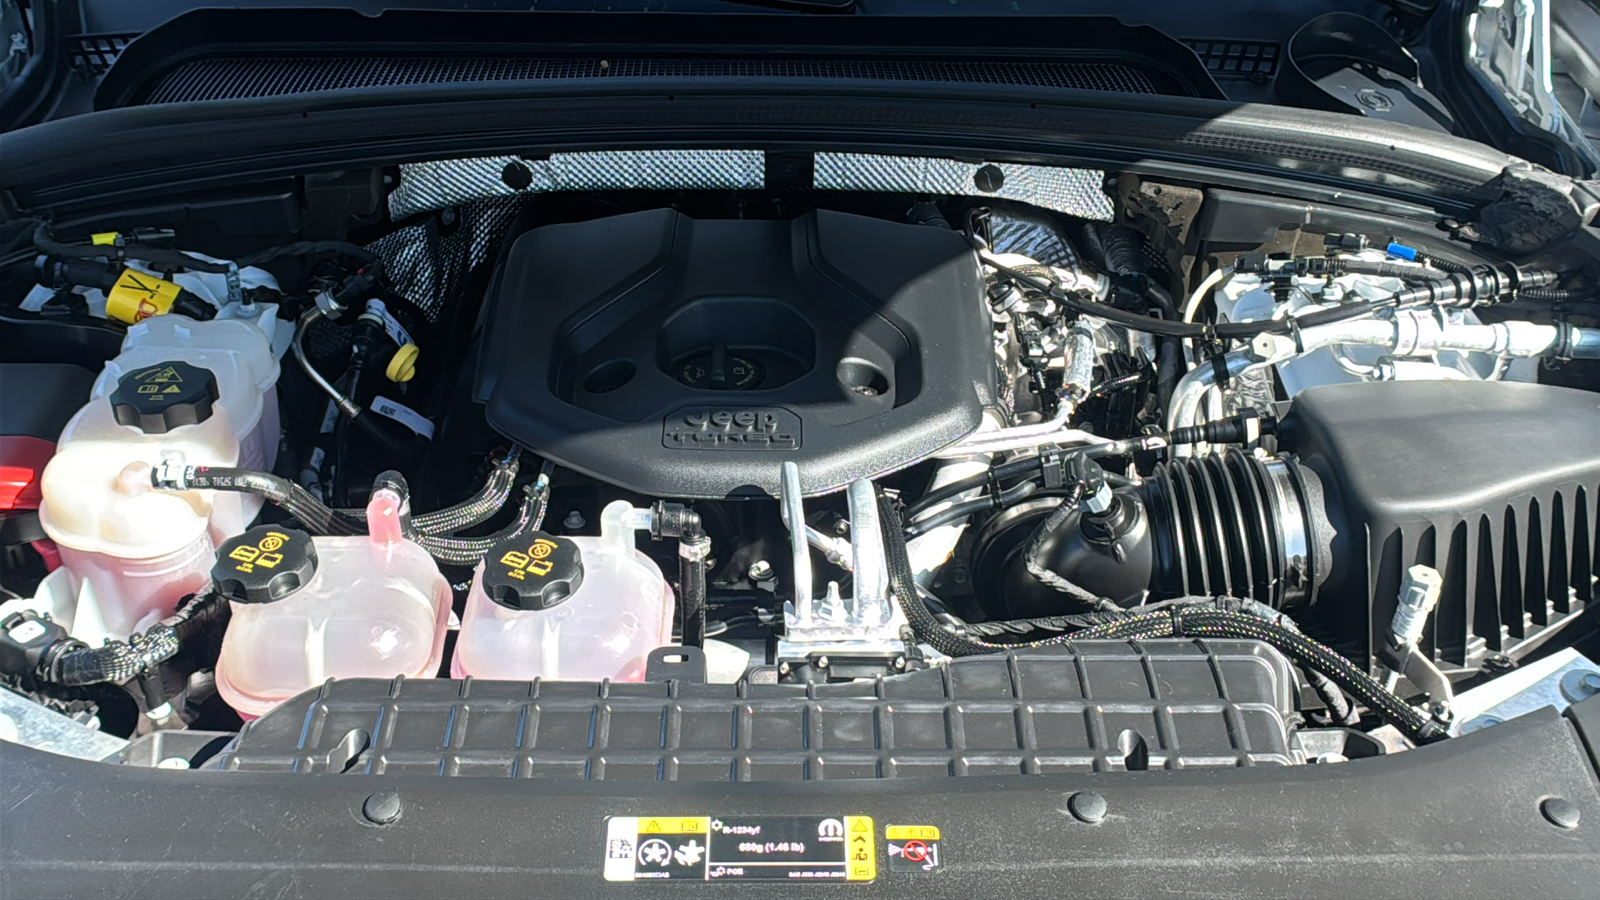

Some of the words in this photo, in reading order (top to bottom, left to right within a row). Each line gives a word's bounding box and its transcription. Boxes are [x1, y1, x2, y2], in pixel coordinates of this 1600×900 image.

[683, 408, 780, 432] Jeep
[722, 825, 761, 836] R-1234yf
[790, 842, 805, 854] lb)
[726, 867, 744, 876] POE
